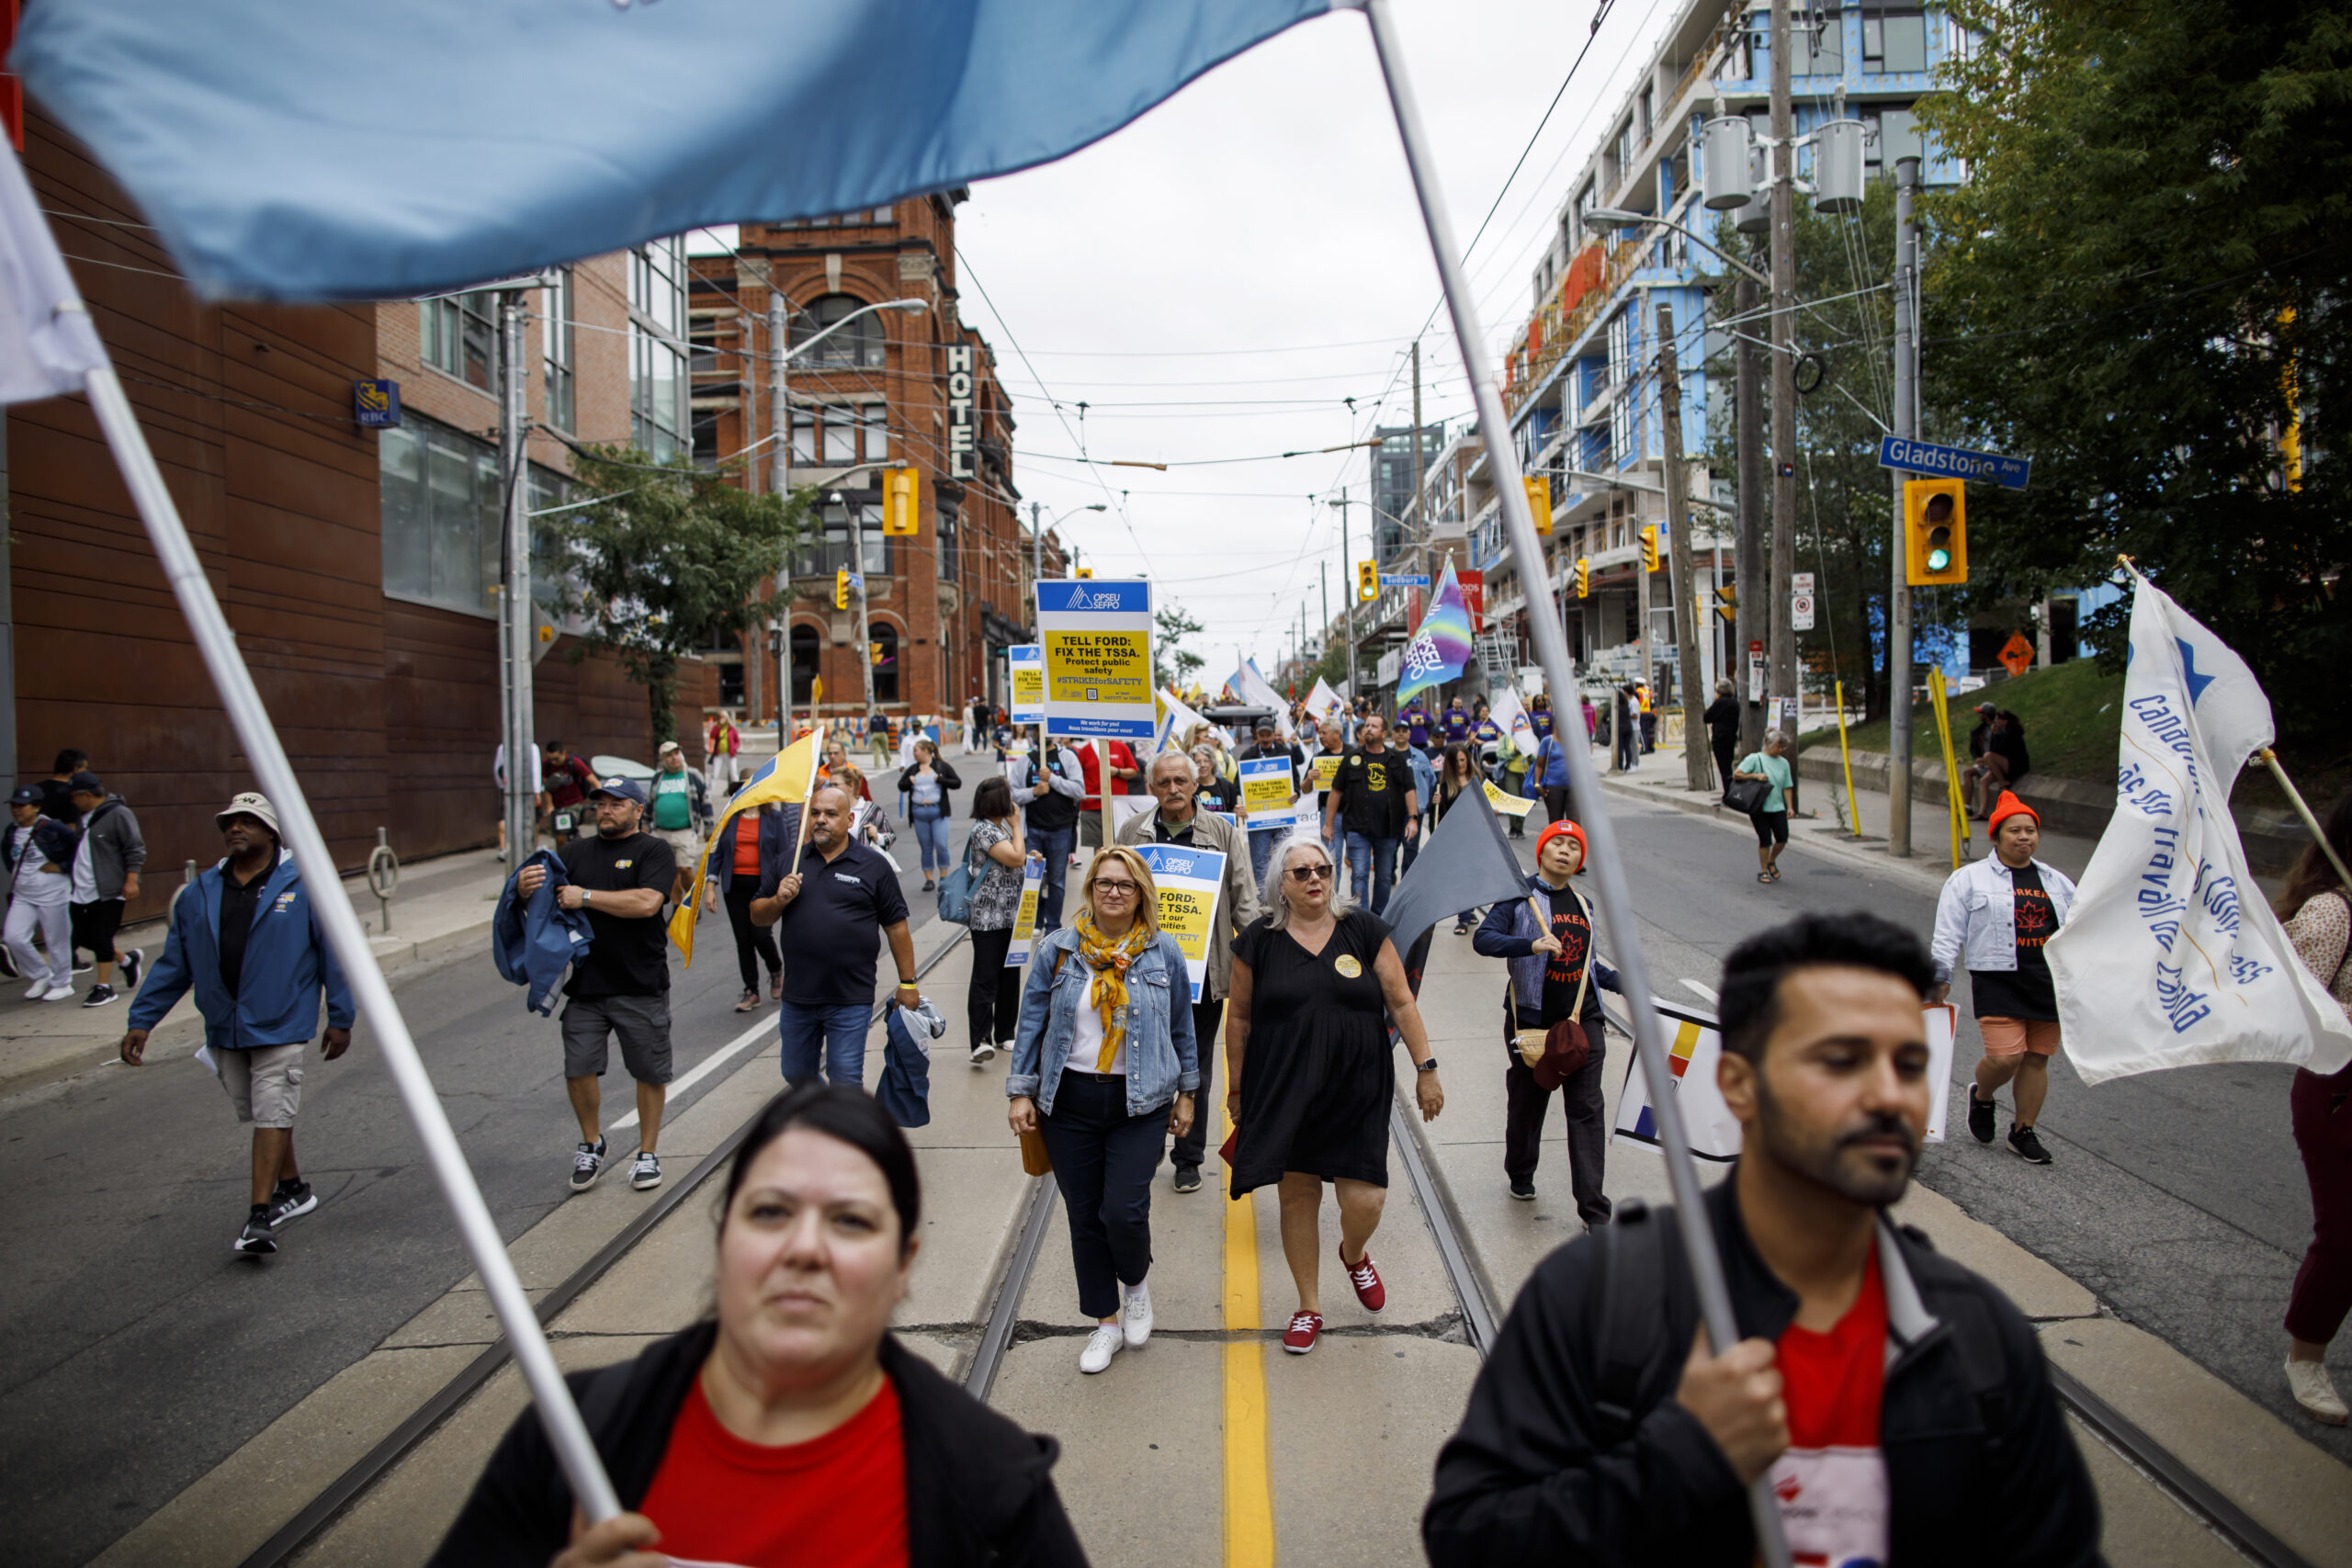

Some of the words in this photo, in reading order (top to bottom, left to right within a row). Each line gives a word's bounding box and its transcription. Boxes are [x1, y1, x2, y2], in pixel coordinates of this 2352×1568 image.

[948, 344, 974, 478] HOTEL
[361, 412, 387, 423] RBC
[1890, 440, 1995, 476] Gladstone
[2001, 460, 2020, 473] Ave
[1386, 576, 1418, 584] Sudbury
[1093, 593, 1120, 602] OPSEU
[1061, 636, 1091, 646] TELL
[1095, 636, 1131, 646] FORD:
[1055, 647, 1074, 656] FIX
[1077, 648, 1102, 657] THE
[1105, 648, 1139, 658] TSSA.
[1416, 628, 1444, 671] OPSEU
[1066, 658, 1100, 666] Protect
[1102, 659, 1130, 667] public
[1084, 667, 1113, 675] safety
[1057, 676, 1142, 685] #STRIKEforSAFETY
[1166, 857, 1193, 868] OPSEU
[1164, 864, 1192, 874] SEFPO
[2138, 826, 2187, 919] travail
[1160, 892, 1195, 904] FORD:
[1168, 904, 1202, 915] TSSA.
